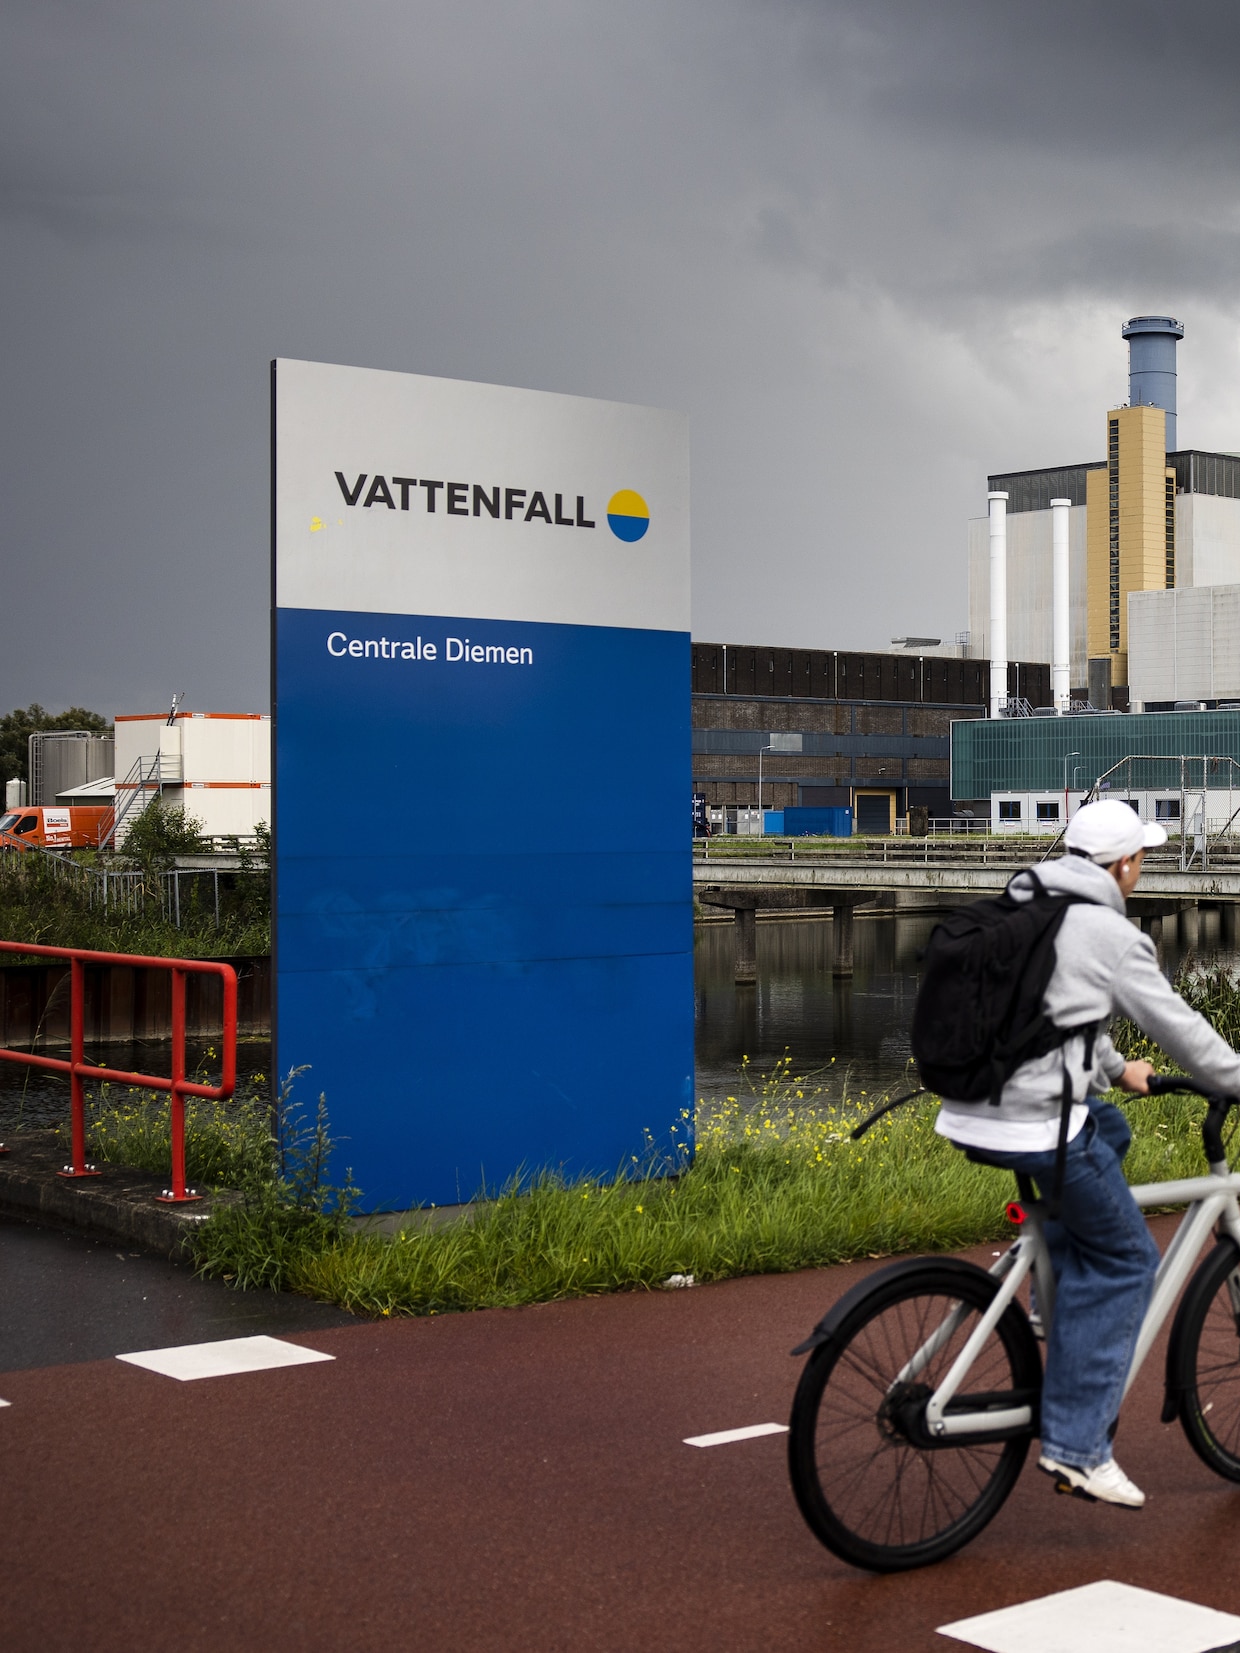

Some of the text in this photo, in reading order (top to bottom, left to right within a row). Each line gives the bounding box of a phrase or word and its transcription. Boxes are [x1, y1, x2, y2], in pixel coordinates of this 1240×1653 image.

[334, 471, 596, 528] VATTENFALL
[326, 631, 534, 665] Centrale Diemen
